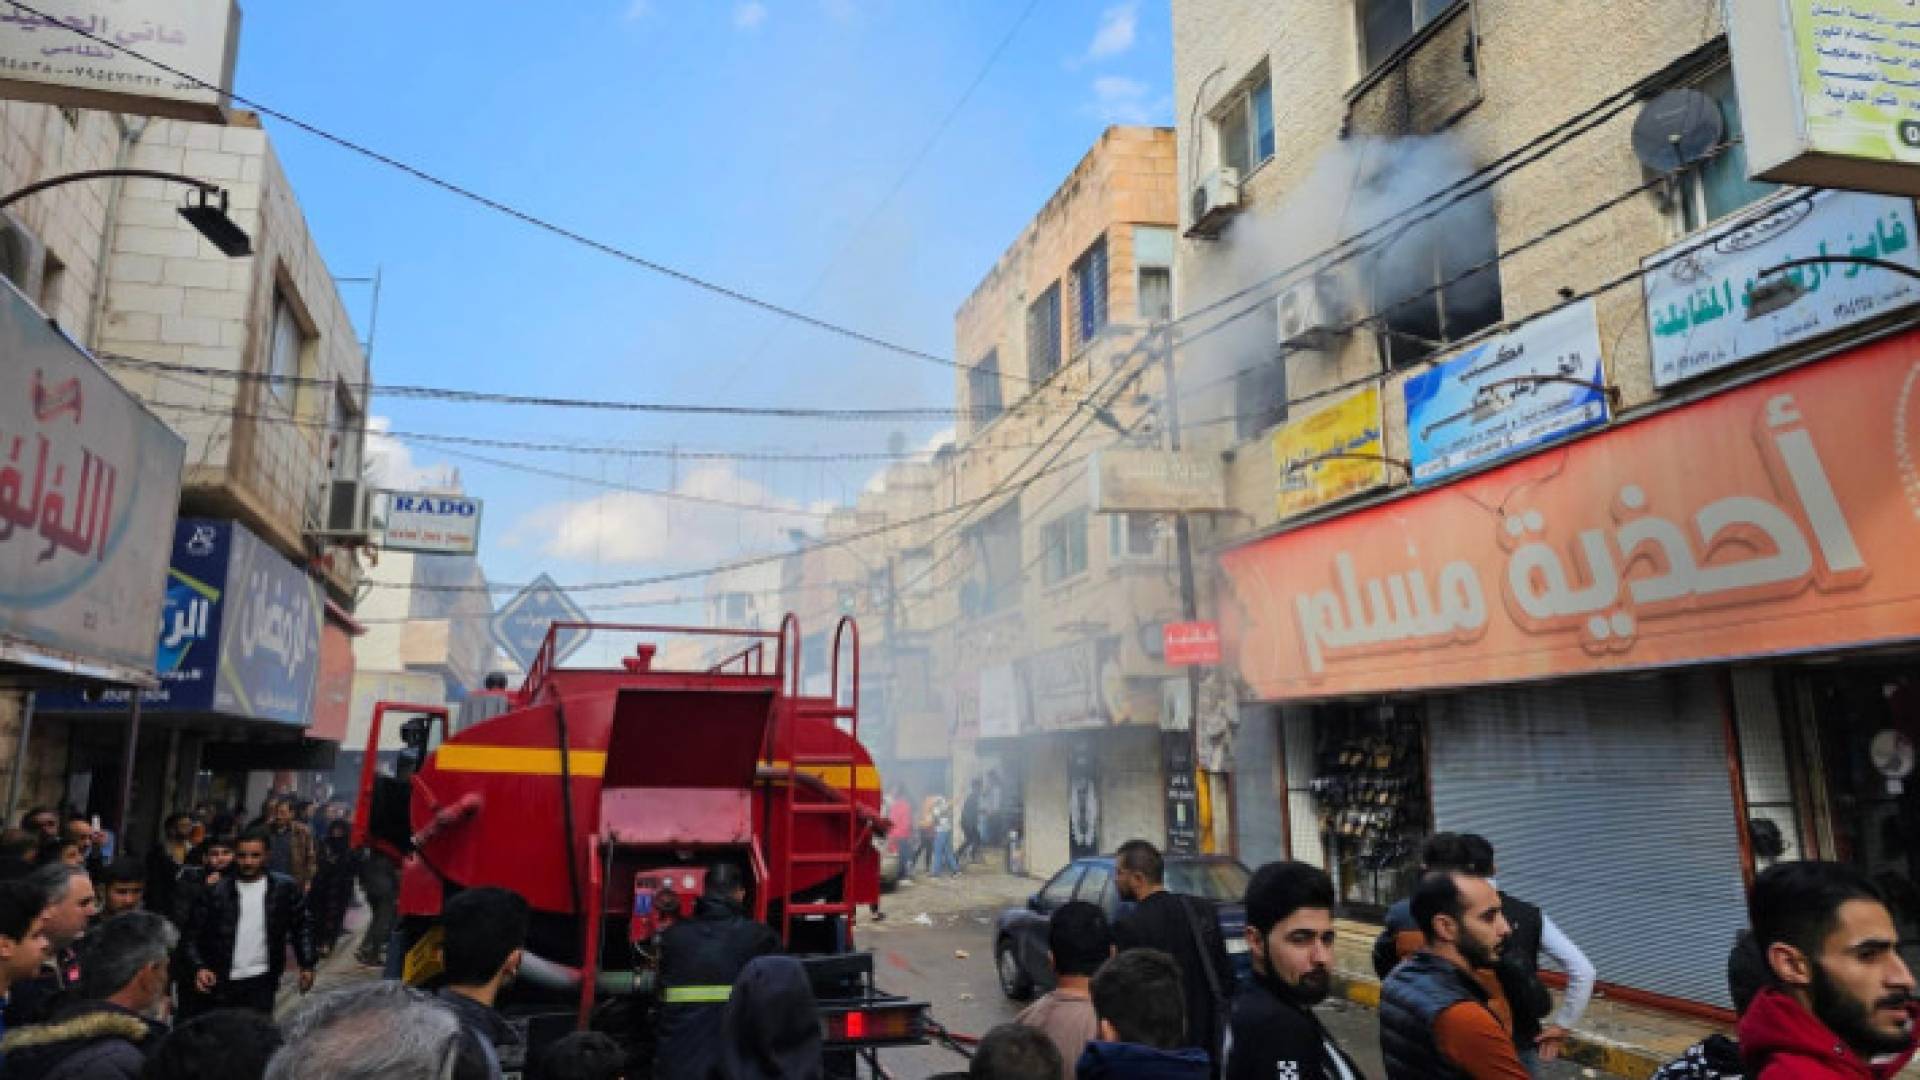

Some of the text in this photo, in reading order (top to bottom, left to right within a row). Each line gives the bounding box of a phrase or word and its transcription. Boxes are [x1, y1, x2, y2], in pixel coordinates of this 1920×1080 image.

[0, 432, 117, 563] اللؤلؤ
[395, 495, 477, 517] RADO
[1509, 395, 1865, 640] أحذية
[160, 599, 209, 649] الر
